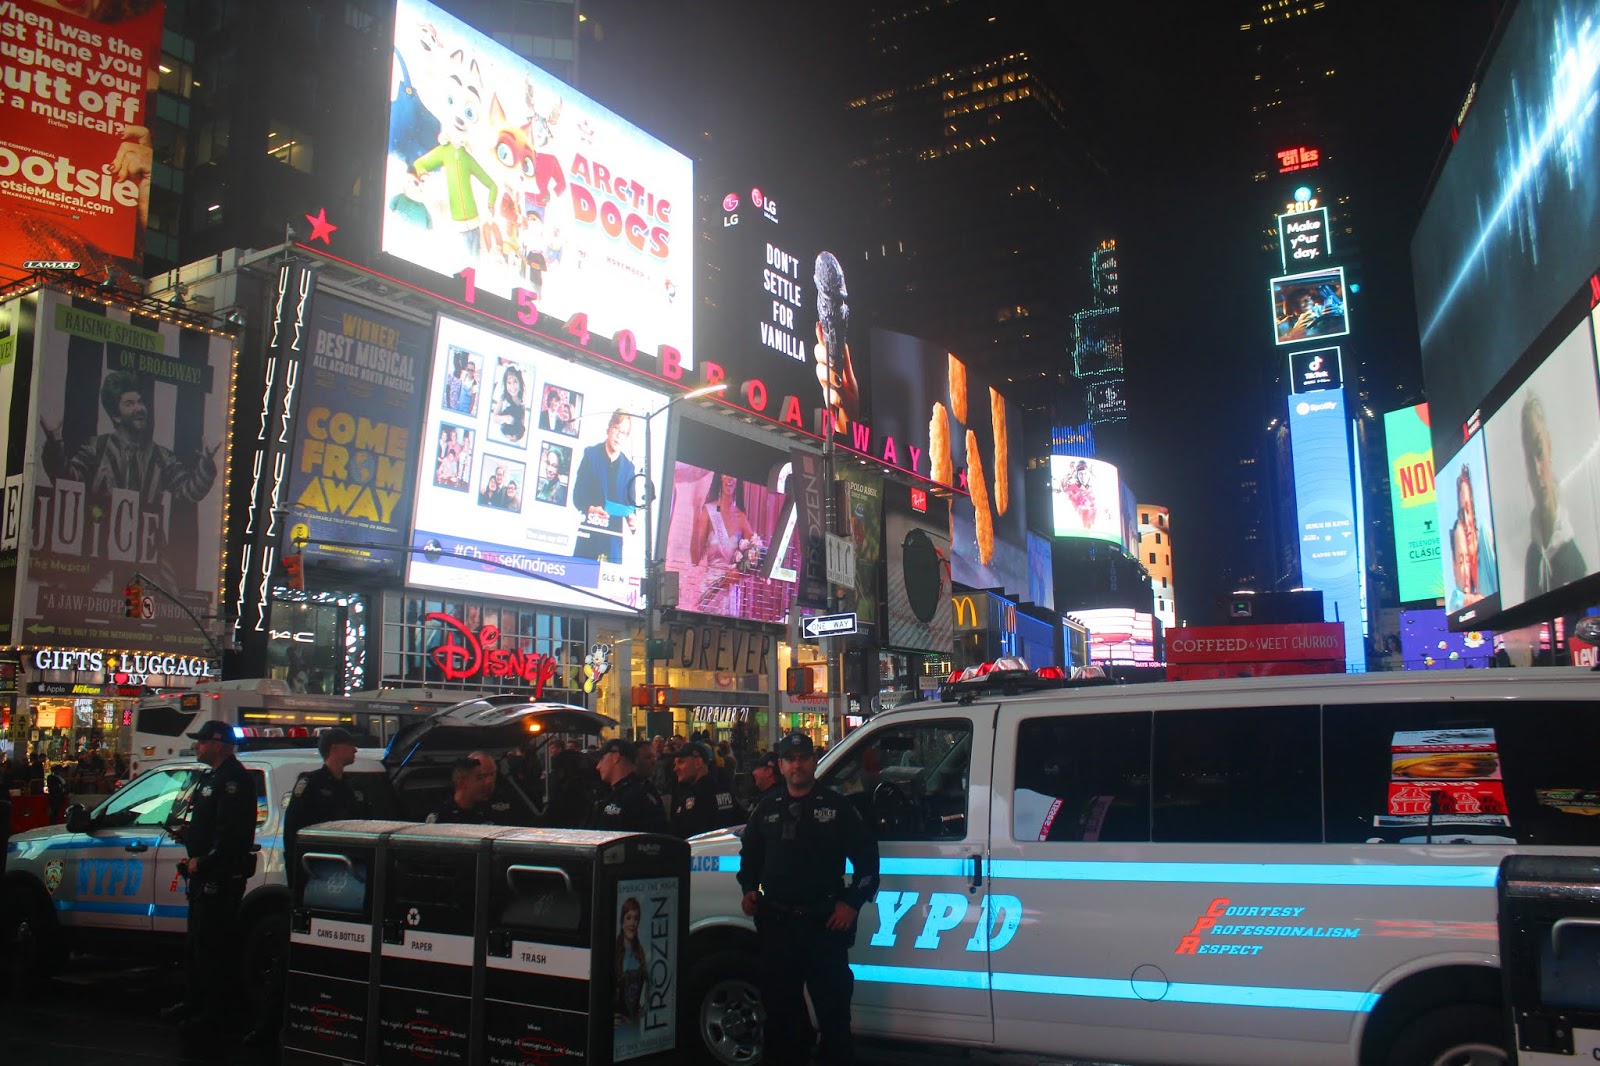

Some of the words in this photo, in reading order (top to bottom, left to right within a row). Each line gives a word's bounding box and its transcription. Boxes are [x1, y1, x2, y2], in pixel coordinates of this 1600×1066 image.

[0, 21, 27, 41] st
[35, 30, 92, 61] time
[99, 53, 142, 78] you
[59, 22, 103, 47] was
[108, 37, 143, 60] the
[86, 68, 141, 95] your
[0, 65, 72, 105] utt
[79, 90, 140, 123] off
[10, 95, 25, 109] a
[8, 142, 32, 153] COMEDY
[32, 148, 56, 159] MUSICAL
[570, 152, 671, 224] ARCTIC
[763, 197, 777, 216] LG
[1286, 199, 1318, 214] 2019
[569, 182, 670, 260] DOGS
[723, 214, 739, 227] LG
[1286, 220, 1320, 234] Make
[1290, 233, 1320, 249] your
[766, 243, 799, 279] DON'T
[1293, 247, 1320, 259] day.
[606, 255, 645, 278] NOVEMBER
[763, 269, 802, 308] SETTLE
[772, 300, 794, 330] FOR
[65, 313, 111, 339] RAISING
[115, 325, 156, 350] SPIRITS
[343, 313, 400, 351] WINNER!
[760, 322, 806, 362] VANILLA
[315, 329, 354, 362] BEST
[355, 340, 415, 381] MUSICAL
[119, 351, 135, 368] ON
[139, 355, 202, 383] BROADWAY!
[313, 355, 327, 369] ALL
[329, 360, 359, 378] ACROSS
[360, 368, 382, 385] NORTH
[384, 375, 415, 394] AMERICA
[658, 344, 921, 472] BROADWAY
[1310, 402, 1337, 412] Spotify
[307, 407, 409, 459] COME
[302, 438, 405, 493] FROM
[850, 481, 864, 492] POLO
[295, 477, 401, 524] AWAY
[803, 473, 823, 583] FROZEN
[454, 544, 566, 577] #ChooseKindness
[1409, 546, 1441, 559] CLÁSIC
[28, 558, 48, 570] The
[50, 560, 91, 574] Musical
[601, 573, 625, 583] GLSN
[58, 627, 72, 636] THIS
[73, 628, 85, 637] WAY
[87, 629, 97, 637] TO
[811, 622, 827, 631] ONE
[833, 620, 850, 628] WAY
[667, 627, 770, 674] FOREVER
[1172, 638, 1248, 652] COFFEED
[1255, 636, 1288, 651] SWEET
[1292, 634, 1339, 649] CHURROS
[36, 650, 103, 672] GIFTS
[46, 685, 66, 694] Apple
[72, 685, 100, 695] Nikon
[109, 673, 114, 684] I
[128, 675, 149, 685] NY
[693, 706, 737, 723] FOREVER
[740, 707, 750, 722] 21
[716, 793, 733, 806] NYPD
[813, 808, 837, 818] POLICE
[690, 856, 719, 871] LICE
[75, 858, 144, 897] NYPD
[1206, 897, 1305, 917] COURTESY
[870, 891, 1023, 952] YPD
[1190, 916, 1361, 938] PROFESSIONALISM
[317, 928, 333, 939] CANS
[334, 931, 338, 940] &
[340, 931, 365, 943] BOTTLES
[411, 941, 433, 952] PAPER
[1175, 935, 1263, 956] RESPECT
[522, 953, 547, 964] TRASH
[644, 895, 672, 1032] FROZEN
